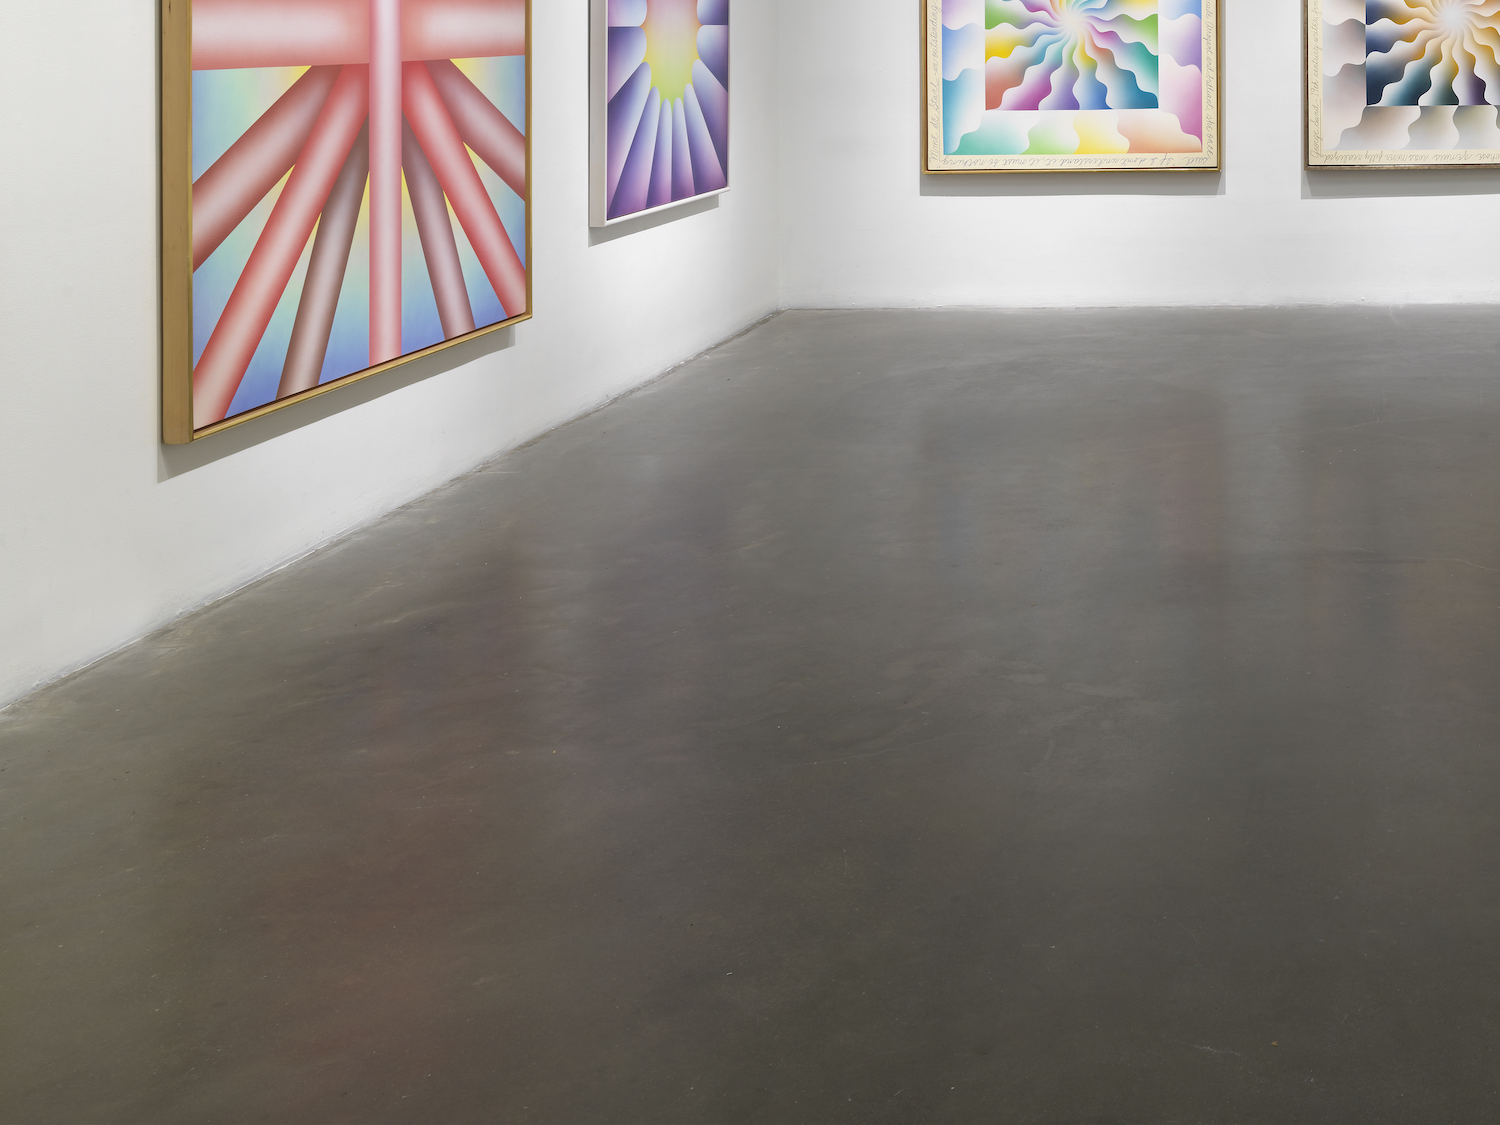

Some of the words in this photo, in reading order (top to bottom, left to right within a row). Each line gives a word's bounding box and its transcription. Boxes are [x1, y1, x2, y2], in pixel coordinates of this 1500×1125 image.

[929, 2, 942, 58] outstanding
[1203, 21, 1214, 55] Arrogant
[932, 60, 938, 72] an
[1206, 56, 1214, 74] and
[1310, 79, 1319, 96] 19th
[930, 114, 939, 129] de
[1205, 113, 1214, 132] she
[929, 133, 938, 163] Mme
[1206, 133, 1214, 159] once
[1310, 128, 1323, 158] George
[986, 159, 1001, 167] be
[1001, 158, 1028, 166] must
[1029, 158, 1041, 167] it
[1060, 158, 1120, 166] understand
[1150, 157, 1158, 165] I
[1323, 151, 1364, 164] realized
[1364, 150, 1384, 164] fully
[1432, 150, 1474, 162] genius
